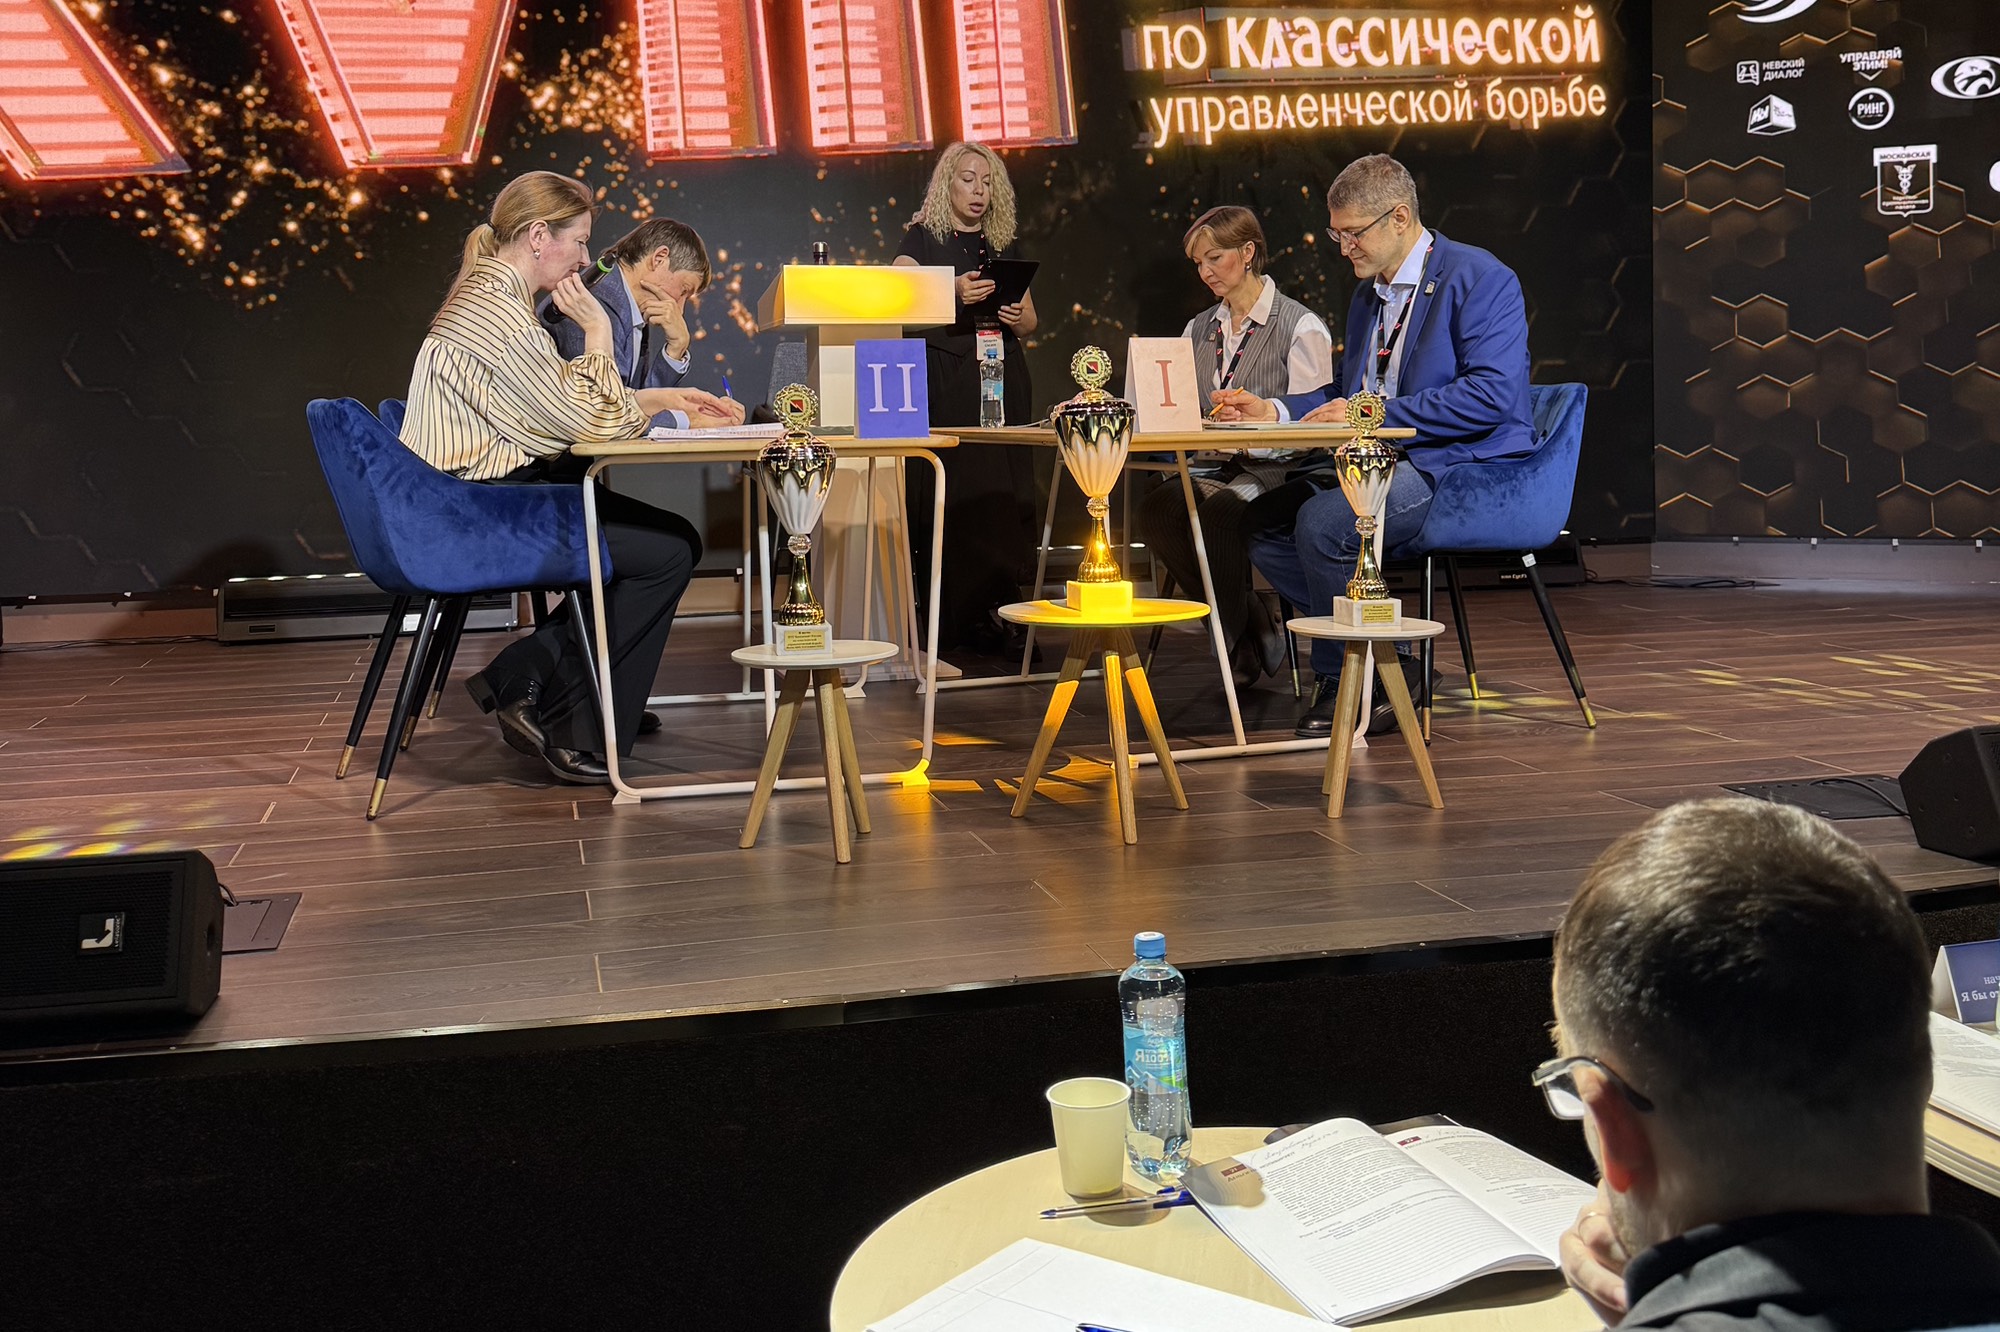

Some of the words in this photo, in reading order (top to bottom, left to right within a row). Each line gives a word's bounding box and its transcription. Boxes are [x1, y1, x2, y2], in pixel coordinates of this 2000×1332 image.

[1142, 24, 1206, 70] по
[1226, 4, 1602, 69] классической
[1839, 46, 1902, 64] УПРАВЛЯЙ
[1762, 57, 1805, 71] НЕВСКИЙ
[1852, 59, 1888, 72] ЭТИМ!
[1763, 69, 1805, 82] ДИАЛОГ
[1150, 79, 1473, 148] управленческой
[1487, 75, 1607, 129] борьбе
[1857, 101, 1886, 115] РИНГ
[1879, 151, 1931, 160] МОСКОВСКАЯ
[1155, 360, 1177, 407] I
[1961, 992, 1970, 1002] Я
[1971, 990, 1987, 1001] бы
